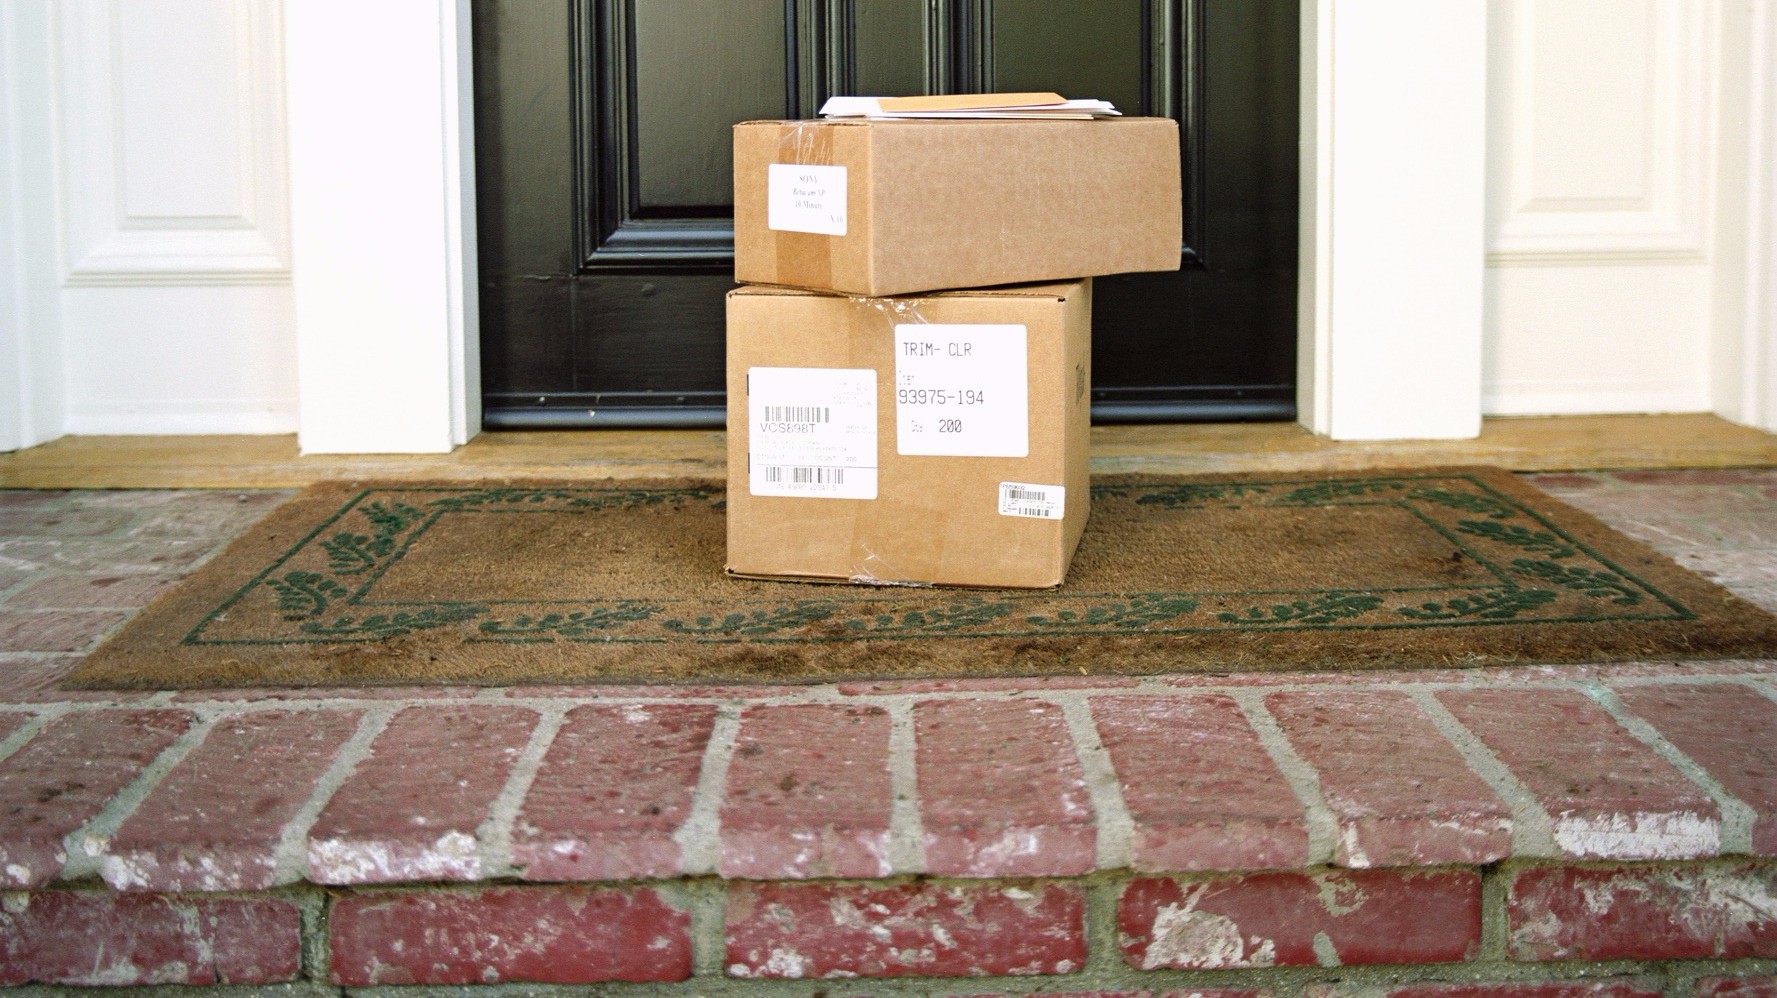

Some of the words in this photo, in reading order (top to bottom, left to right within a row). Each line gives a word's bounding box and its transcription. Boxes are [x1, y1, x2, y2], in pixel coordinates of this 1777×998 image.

[903, 342, 941, 357] TRIM-
[948, 342, 972, 357] CLR
[898, 389, 985, 405] 93975-194
[759, 422, 817, 434] VCS898T
[939, 419, 962, 433] 200
